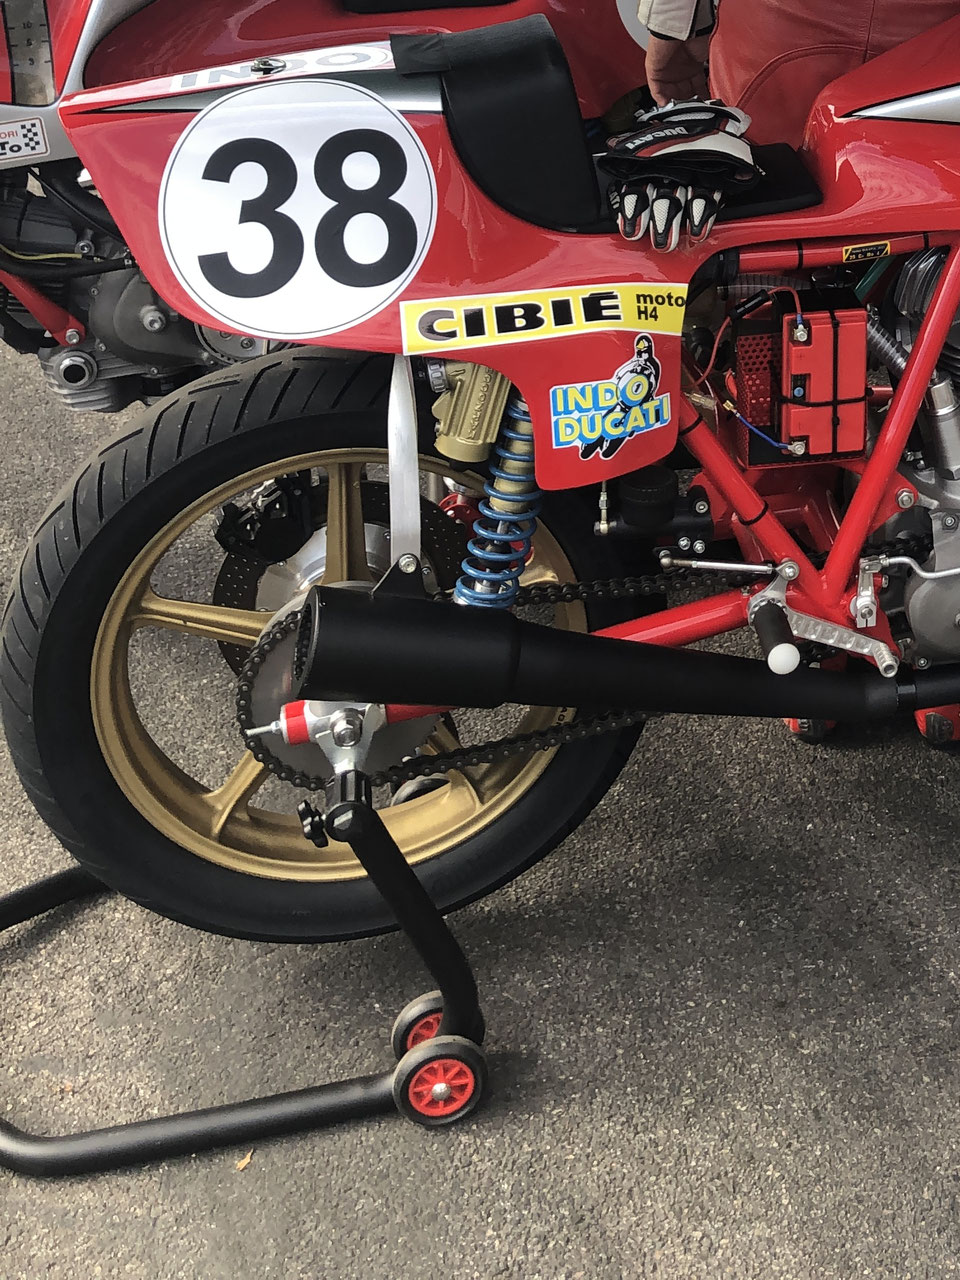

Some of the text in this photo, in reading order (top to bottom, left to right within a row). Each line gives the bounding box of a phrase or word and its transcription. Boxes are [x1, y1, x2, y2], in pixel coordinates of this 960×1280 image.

[625, 126, 689, 150] DUCATI
[197, 128, 418, 299] 38
[635, 292, 686, 308] moto
[637, 306, 658, 321] H4
[556, 374, 649, 412] INDO
[558, 395, 670, 443] DUCATI
